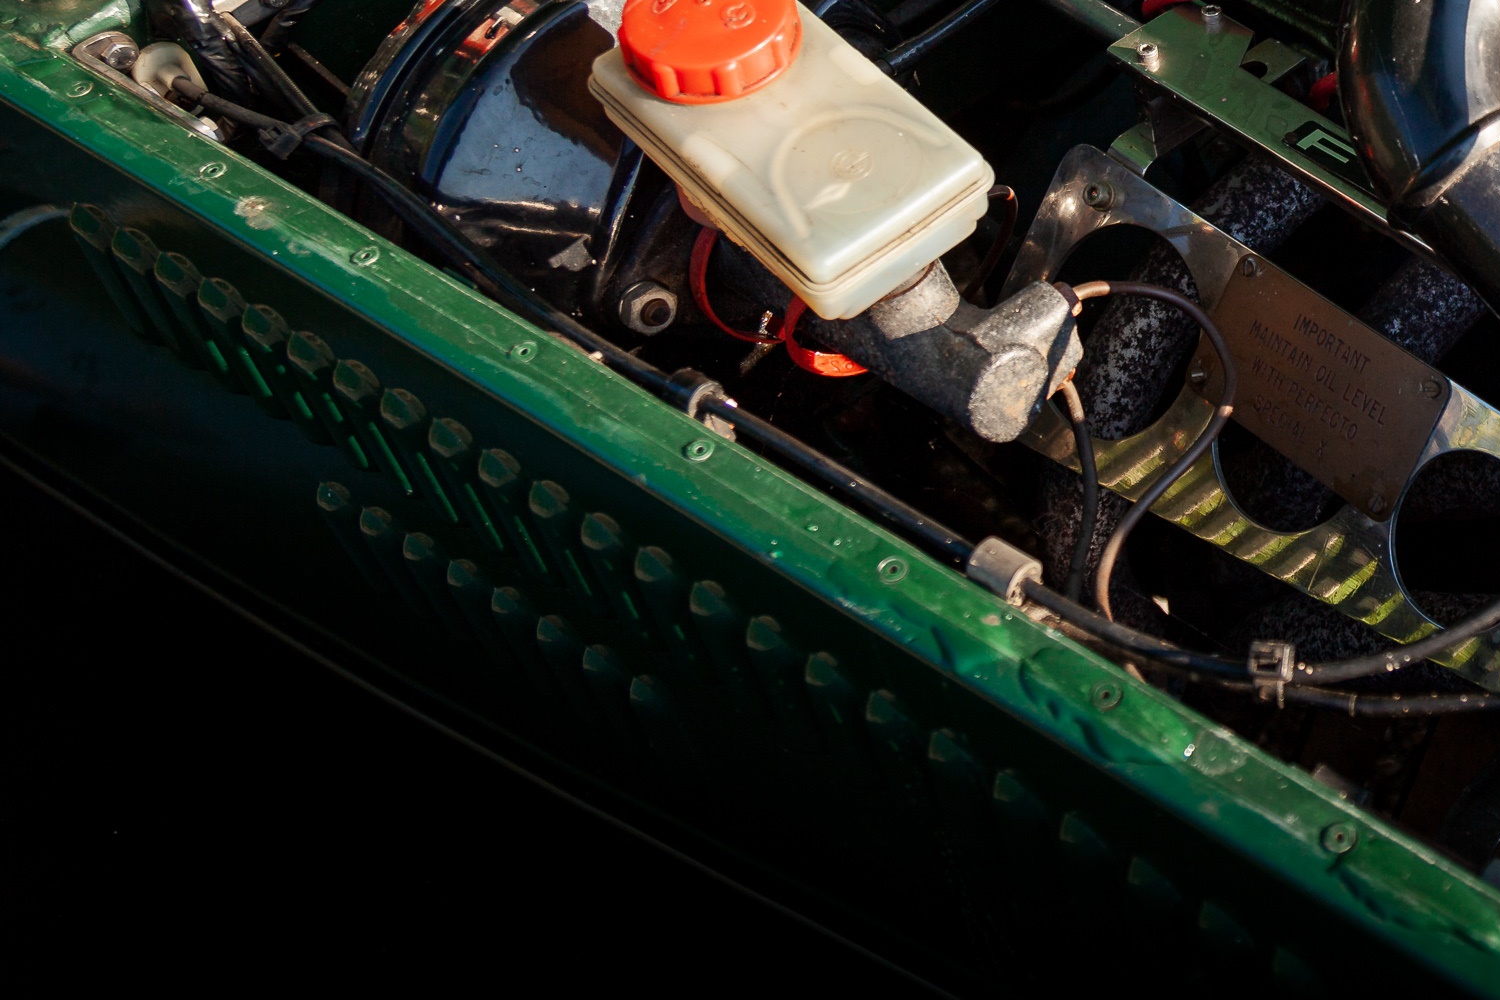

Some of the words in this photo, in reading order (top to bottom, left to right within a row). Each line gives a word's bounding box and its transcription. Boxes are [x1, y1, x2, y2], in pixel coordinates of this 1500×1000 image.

[1249, 319, 1314, 374] MAINTAIN
[1314, 365, 1336, 393] OIL
[1343, 383, 1387, 427] LEVEL
[1293, 313, 1372, 375] IMPORTANT
[1251, 356, 1286, 391] WITH
[1287, 381, 1359, 441] PERFECTO
[1252, 394, 1307, 444] SPECIAL
